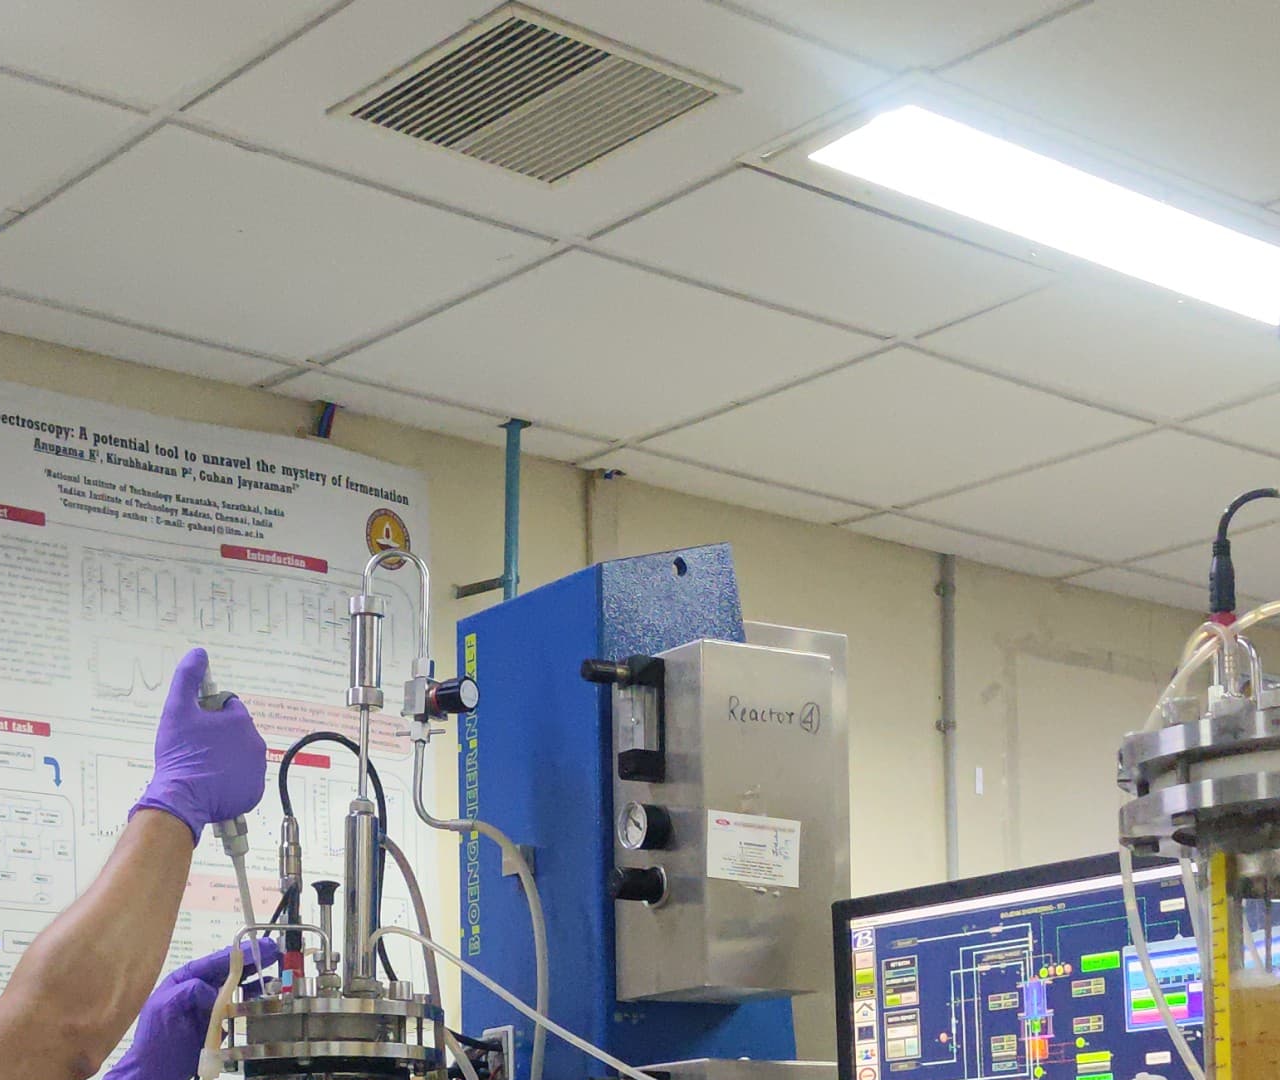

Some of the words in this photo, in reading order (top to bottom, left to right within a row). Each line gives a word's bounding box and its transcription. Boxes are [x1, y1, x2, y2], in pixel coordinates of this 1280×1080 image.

[34, 438, 84, 458] Anupama
[106, 453, 177, 476] Kirubhakaran
[200, 470, 233, 485] Guhan
[79, 426, 88, 440] A
[93, 433, 149, 453] potential
[155, 443, 179, 459] tool
[185, 450, 197, 462] to
[202, 454, 251, 470] unravel
[256, 459, 276, 473] the
[281, 465, 327, 486] mystery
[331, 475, 342, 487] of
[346, 477, 409, 505] fermentation
[84, 476, 116, 490] Institute
[119, 484, 127, 493] of
[130, 485, 172, 503] Technology
[176, 494, 219, 509] Karnataka,
[264, 506, 285, 517] India
[89, 490, 122, 504] Institute
[125, 498, 133, 506] of
[135, 499, 178, 516] Technology
[182, 507, 212, 520] Madras,
[215, 512, 250, 526] Chennai,
[252, 517, 273, 528] India
[122, 512, 147, 522] author
[246, 549, 306, 568] Introduction
[12, 722, 35, 734] task
[728, 696, 794, 724] Reactor
[801, 705, 817, 732] 4
